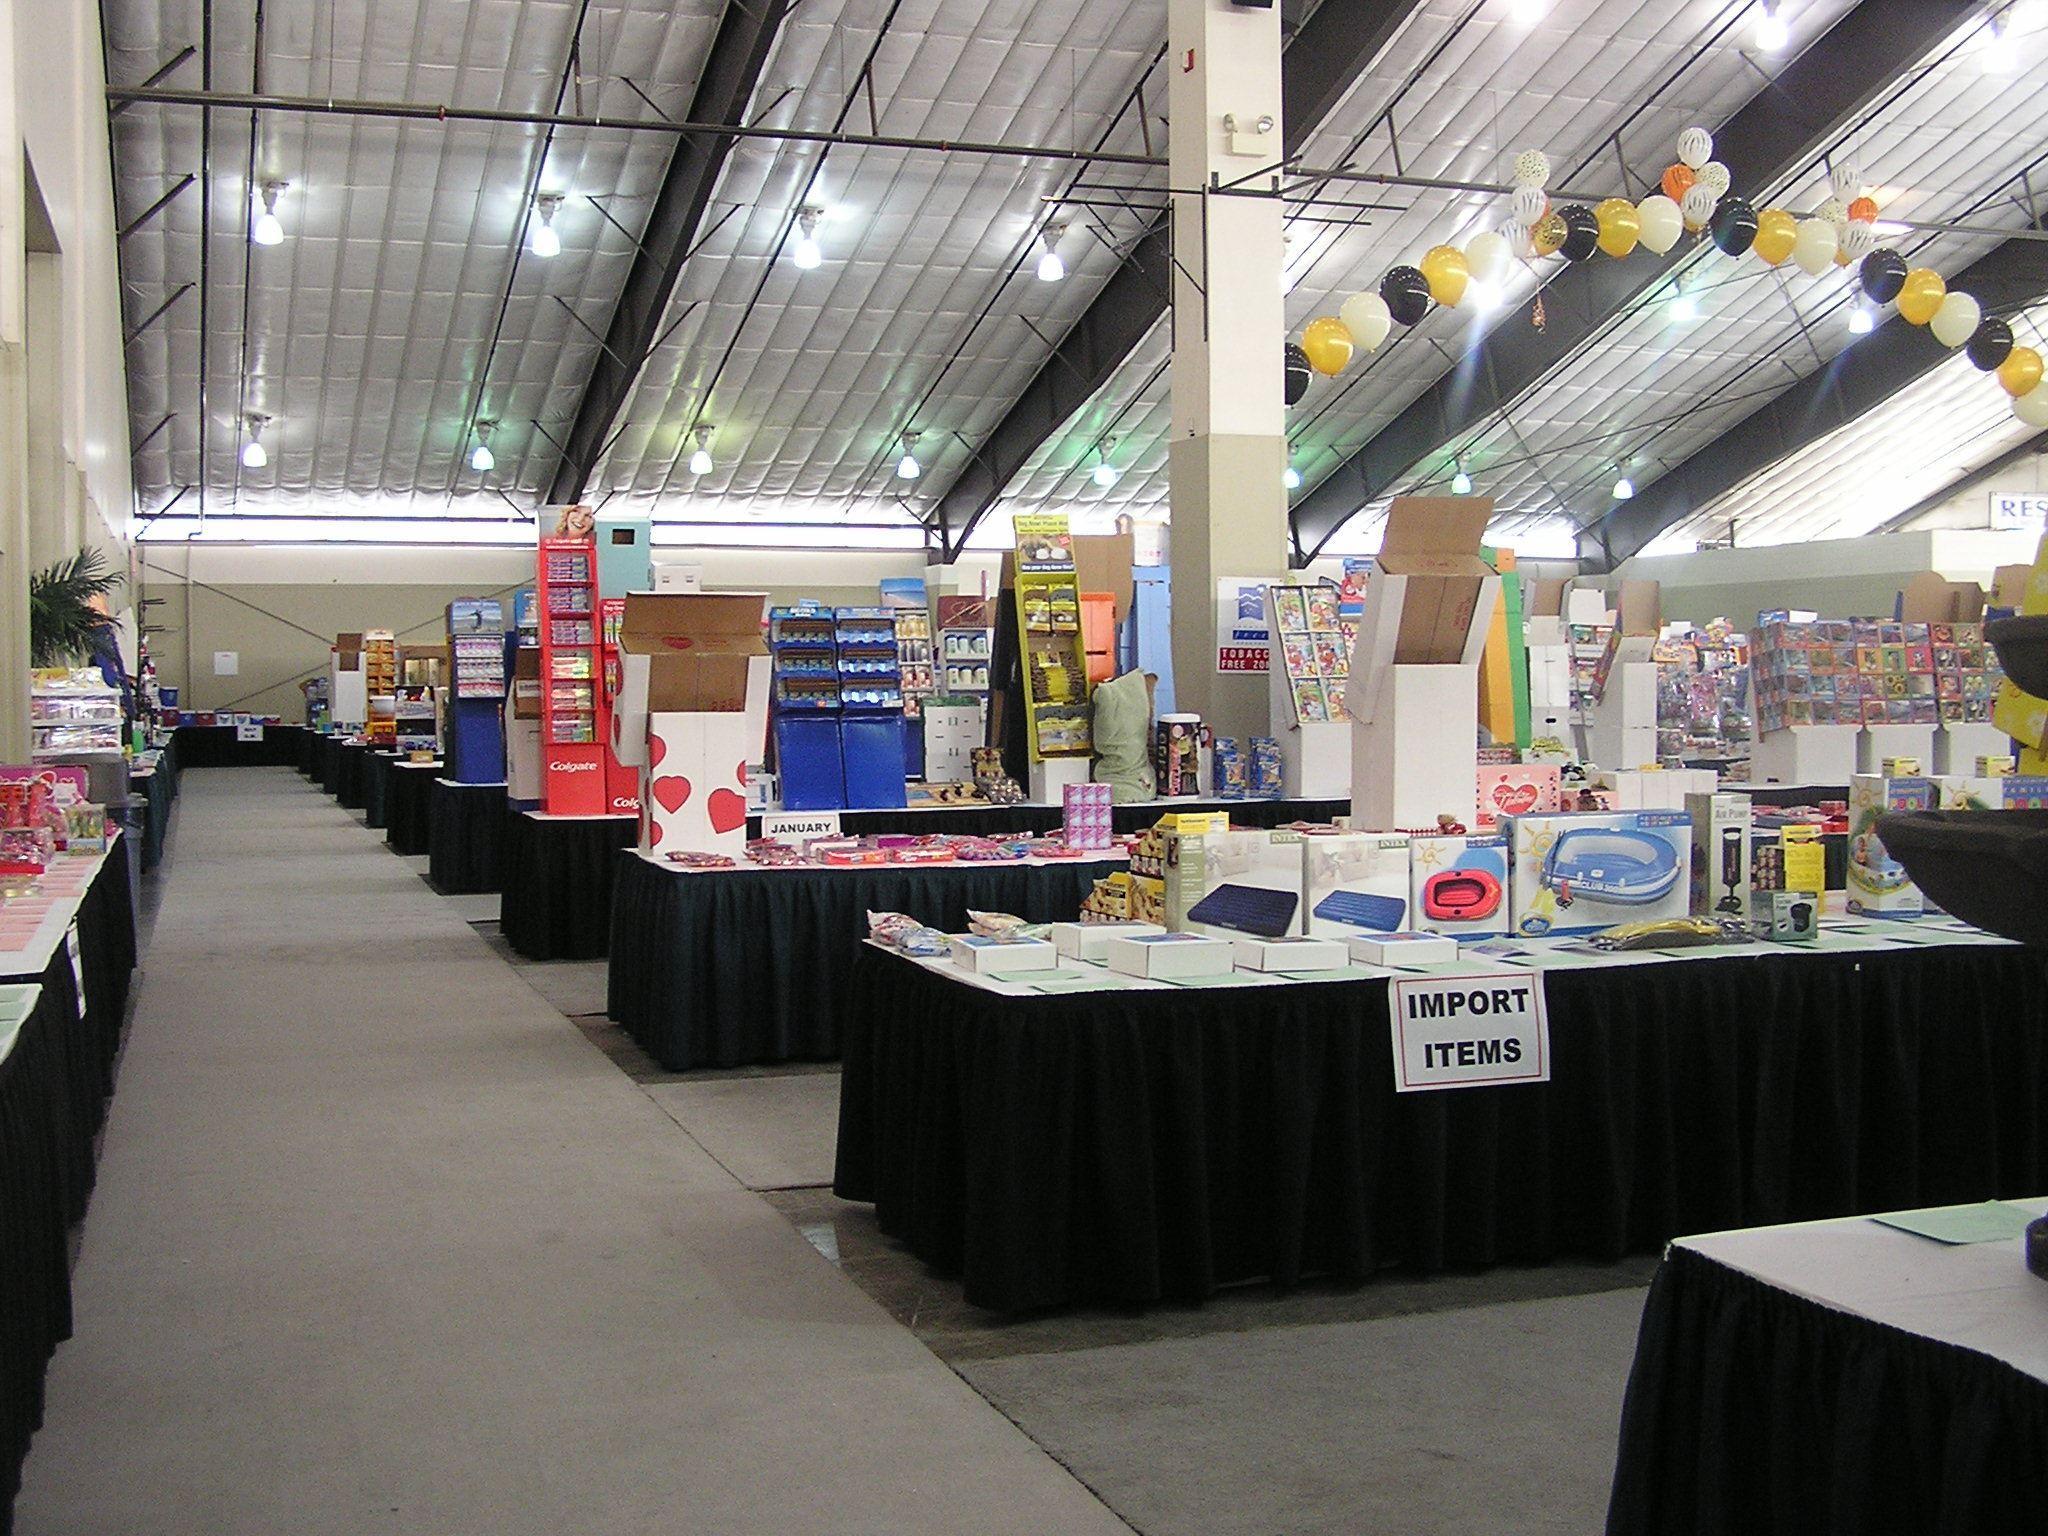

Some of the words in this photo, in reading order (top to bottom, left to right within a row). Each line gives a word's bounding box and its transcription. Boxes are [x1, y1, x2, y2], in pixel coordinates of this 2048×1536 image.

[1222, 649, 1270, 659] TOBACC
[1221, 660, 1246, 669] FREE
[1253, 660, 1270, 669] ZO
[550, 761, 597, 773] Colgate
[613, 797, 640, 810] Colg
[771, 822, 832, 834] JANUARY
[1408, 988, 1529, 1019] IMPORT
[1425, 1037, 1522, 1068] ITEMS
